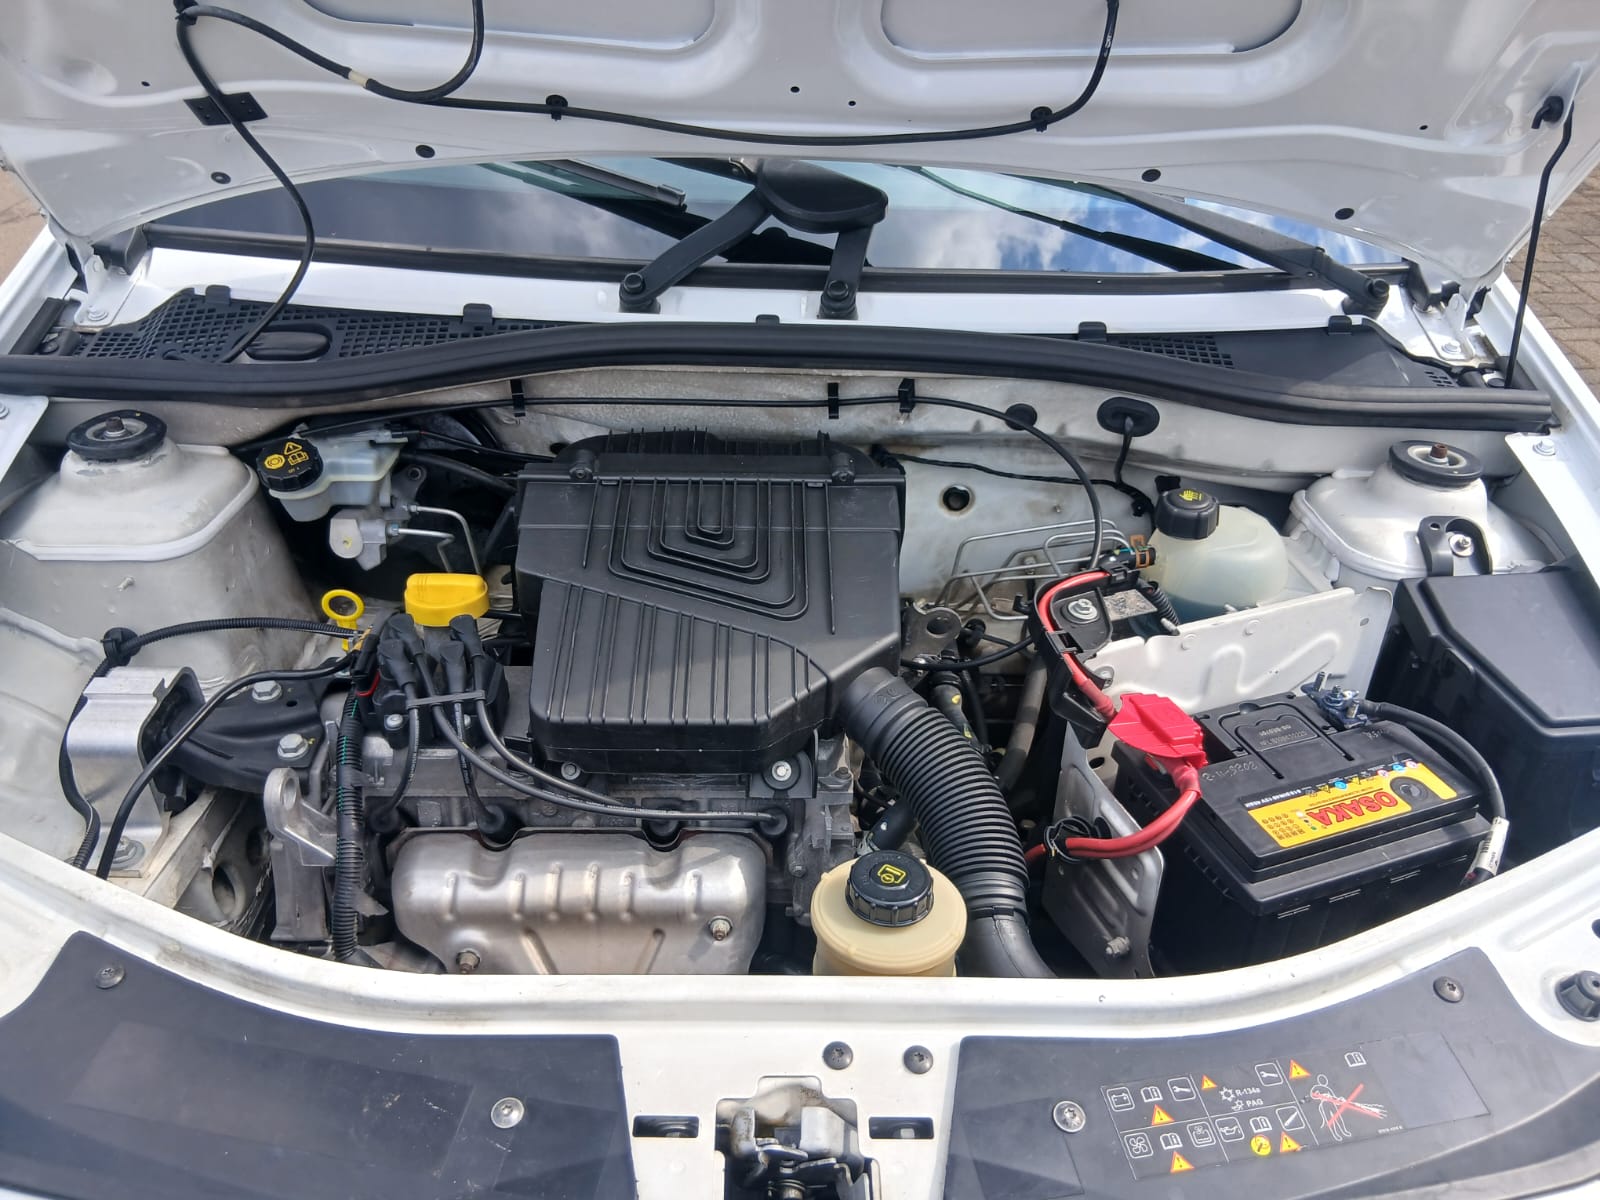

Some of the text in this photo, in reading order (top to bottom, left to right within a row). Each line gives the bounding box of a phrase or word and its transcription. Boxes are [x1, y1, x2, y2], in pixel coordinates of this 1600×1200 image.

[1306, 791, 1399, 827] OSAKA
[1235, 1087, 1262, 1097] R-134a
[1246, 1098, 1264, 1107] PAG
